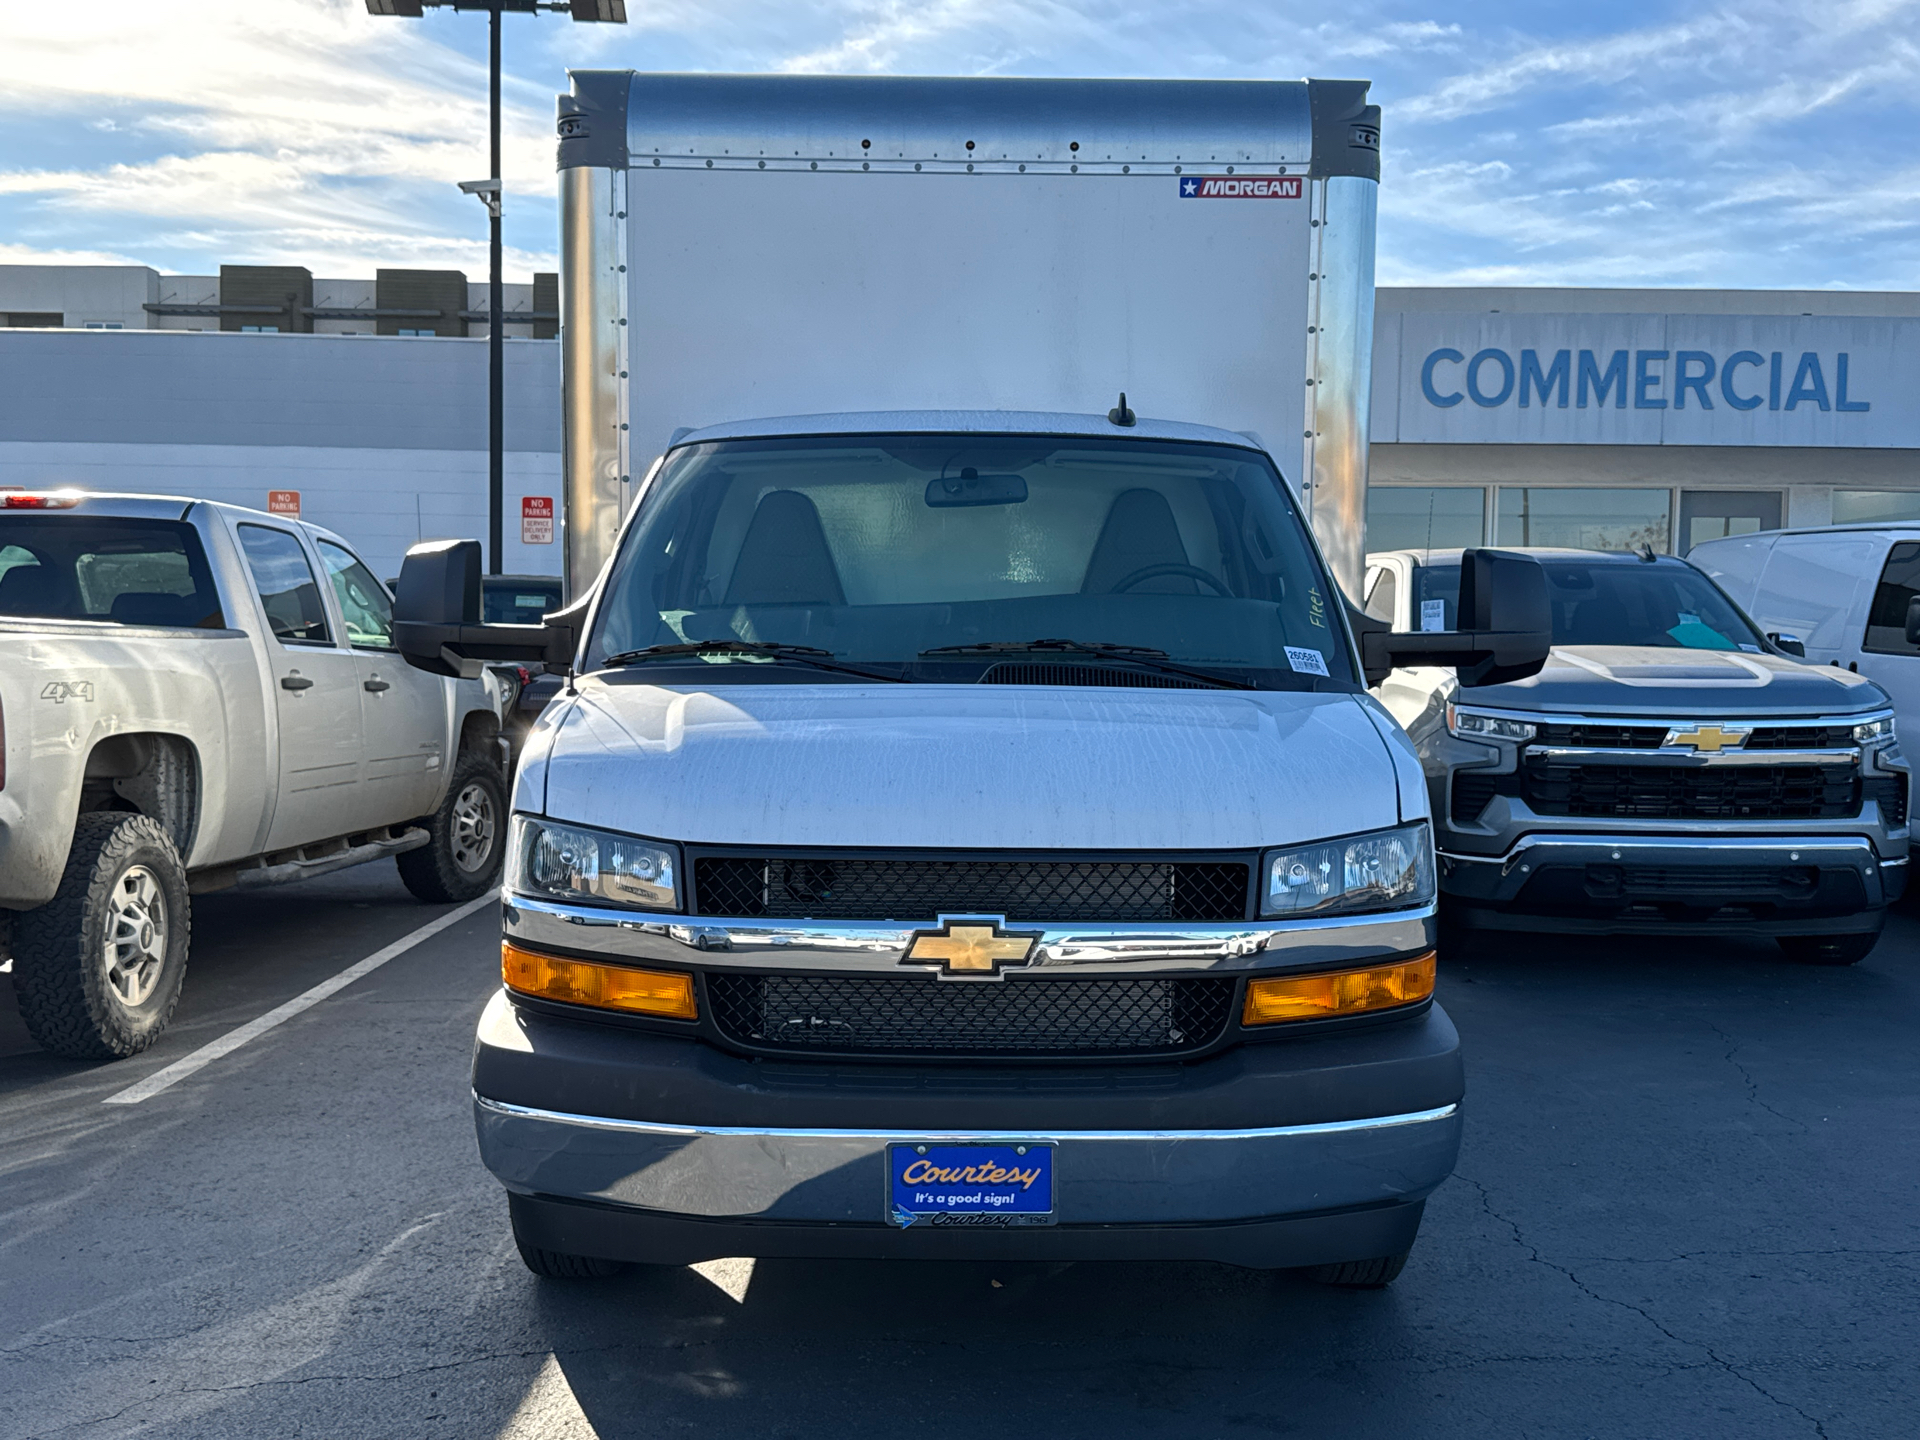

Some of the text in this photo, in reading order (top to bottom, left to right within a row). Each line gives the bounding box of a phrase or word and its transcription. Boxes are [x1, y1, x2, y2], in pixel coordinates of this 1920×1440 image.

[1202, 181, 1297, 196] MORGAN
[1420, 347, 1870, 412] COMMERCIAL
[278, 493, 291, 502] NO
[531, 499, 544, 508] NO
[271, 502, 298, 511] PARKING
[524, 507, 551, 517] PARKING
[1308, 587, 1325, 629] Fleet
[903, 1159, 1042, 1191] Courtesy
[915, 1192, 1015, 1206] It's a good sign!
[931, 1210, 1014, 1228] Courtesy
